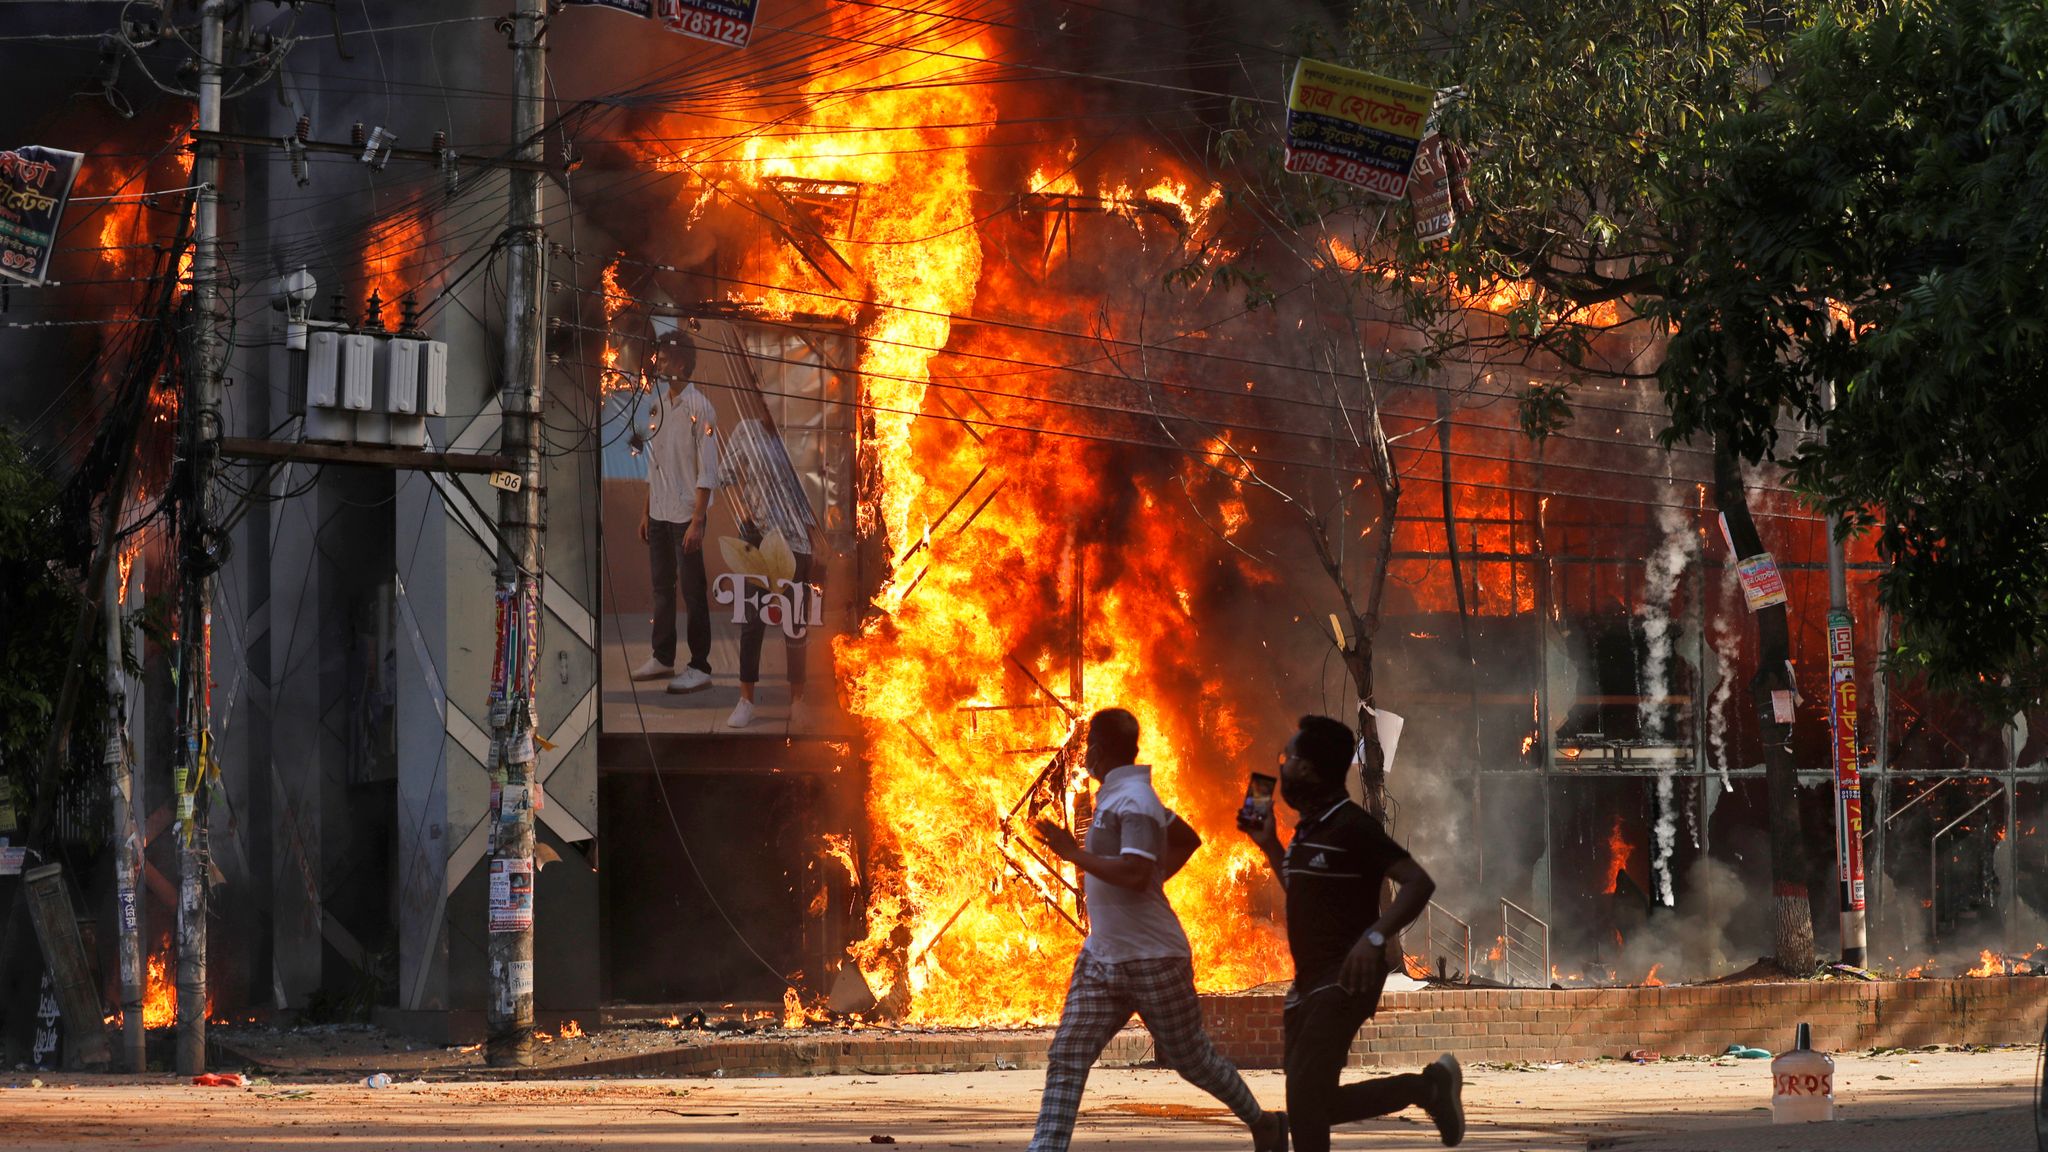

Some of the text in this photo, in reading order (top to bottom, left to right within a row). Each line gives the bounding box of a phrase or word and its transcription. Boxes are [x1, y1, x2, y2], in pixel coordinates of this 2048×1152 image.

[680, 9, 748, 45] 785122
[1301, 86, 1336, 111] ছাত্র
[1340, 95, 1424, 135] হোস্টেল
[494, 472, 520, 489] T-06
[712, 572, 824, 639] Fall
